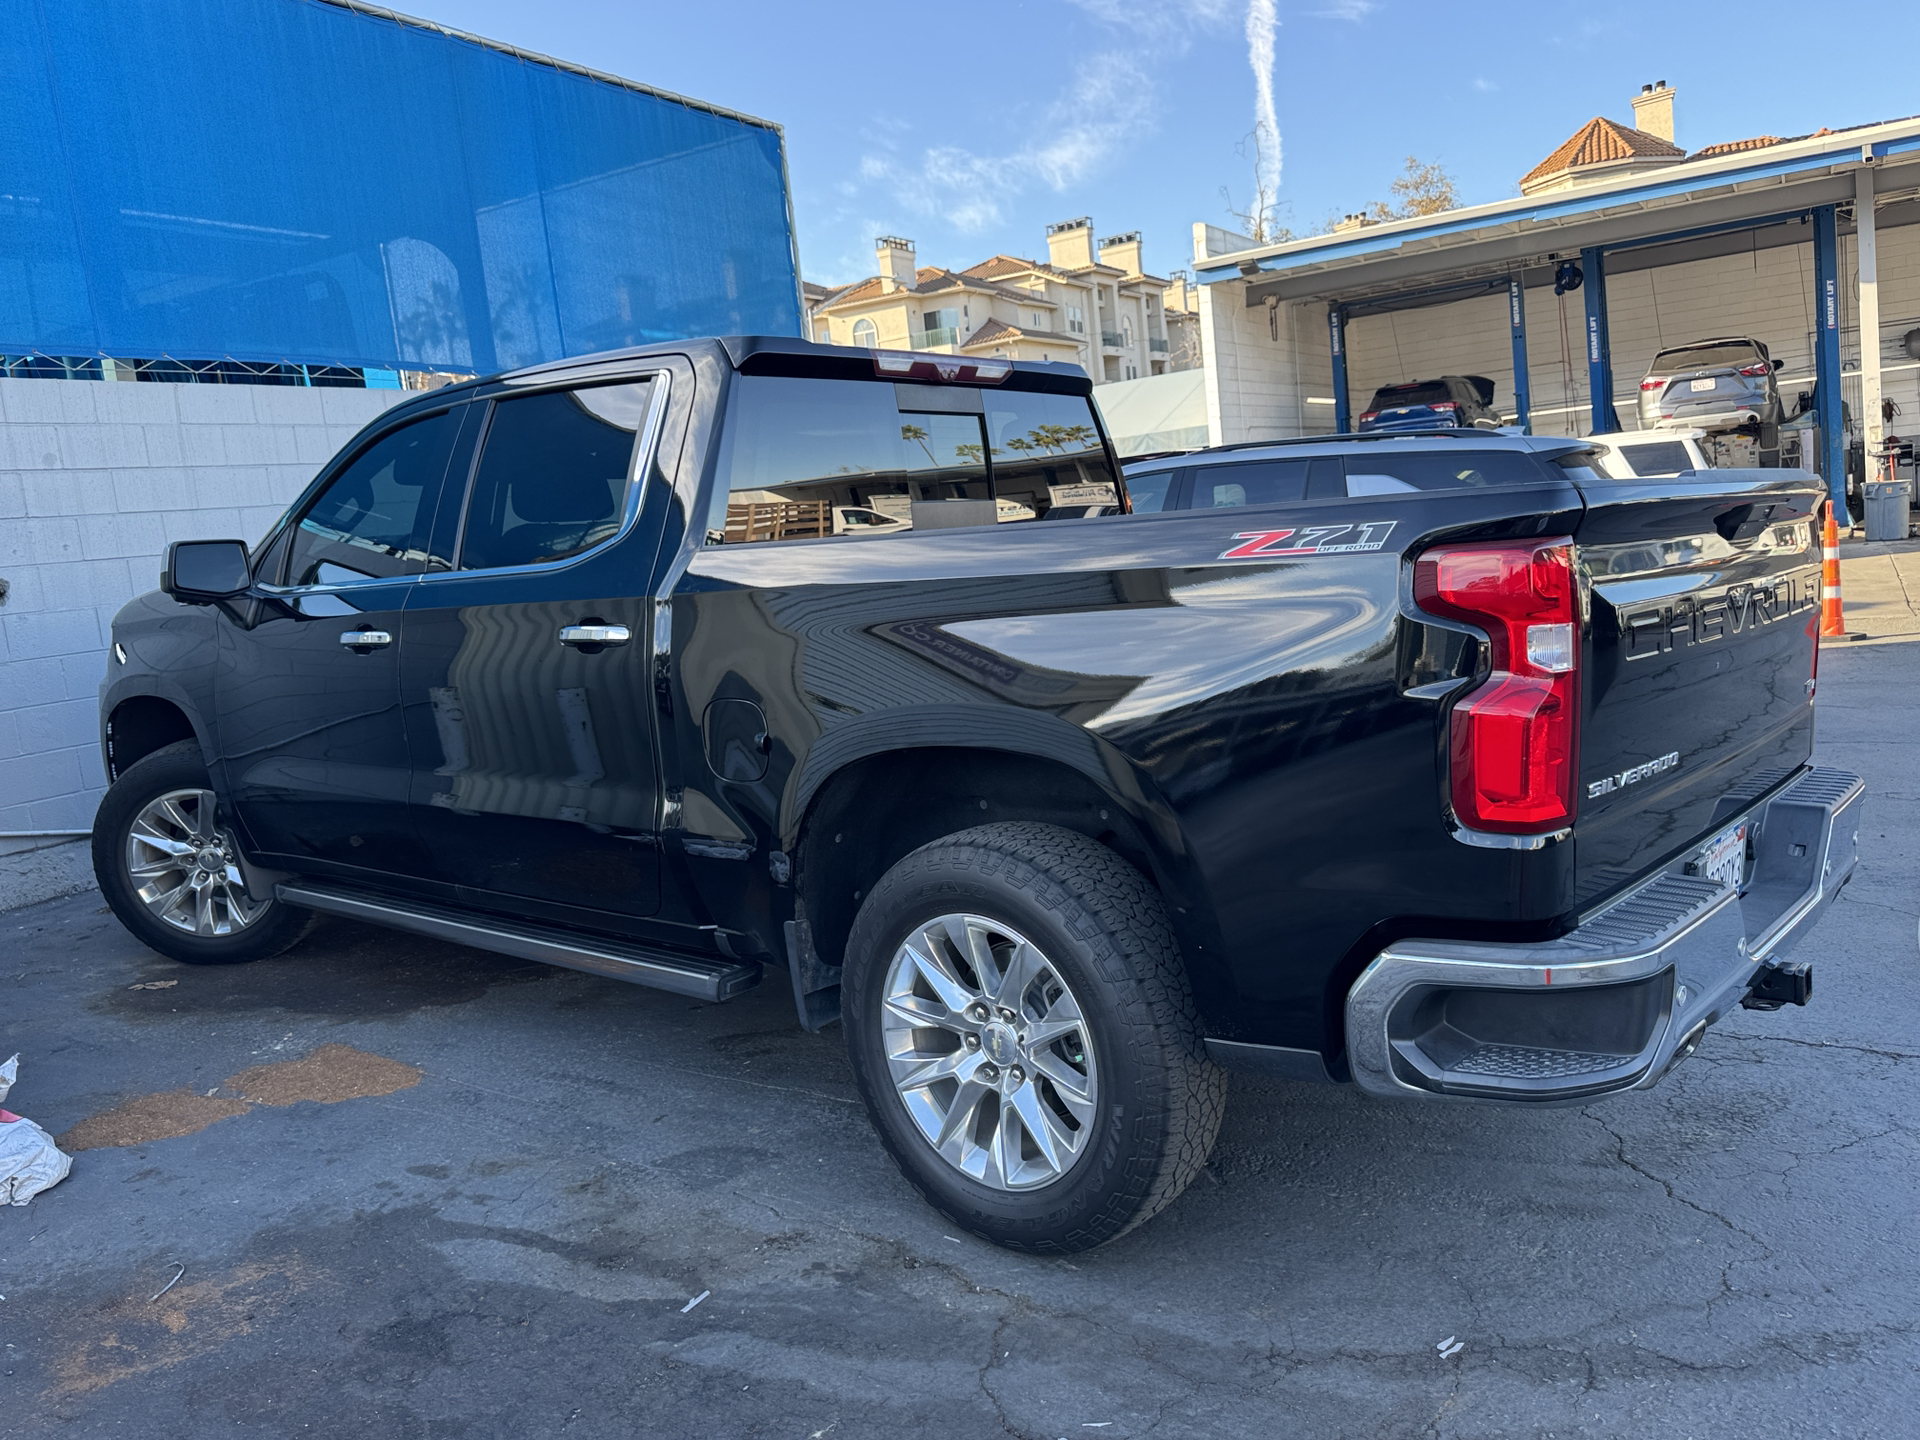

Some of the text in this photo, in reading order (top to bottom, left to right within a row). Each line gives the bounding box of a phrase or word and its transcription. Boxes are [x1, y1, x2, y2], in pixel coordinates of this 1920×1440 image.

[1512, 298, 1520, 323] ROTARY
[1827, 297, 1835, 325] ROTARY
[1589, 316, 1598, 358] ROTARY LIFT
[1217, 521, 1397, 559] Z71
[1587, 751, 1679, 799] SILVERADO
[971, 1104, 1124, 1231] WRANGLER
